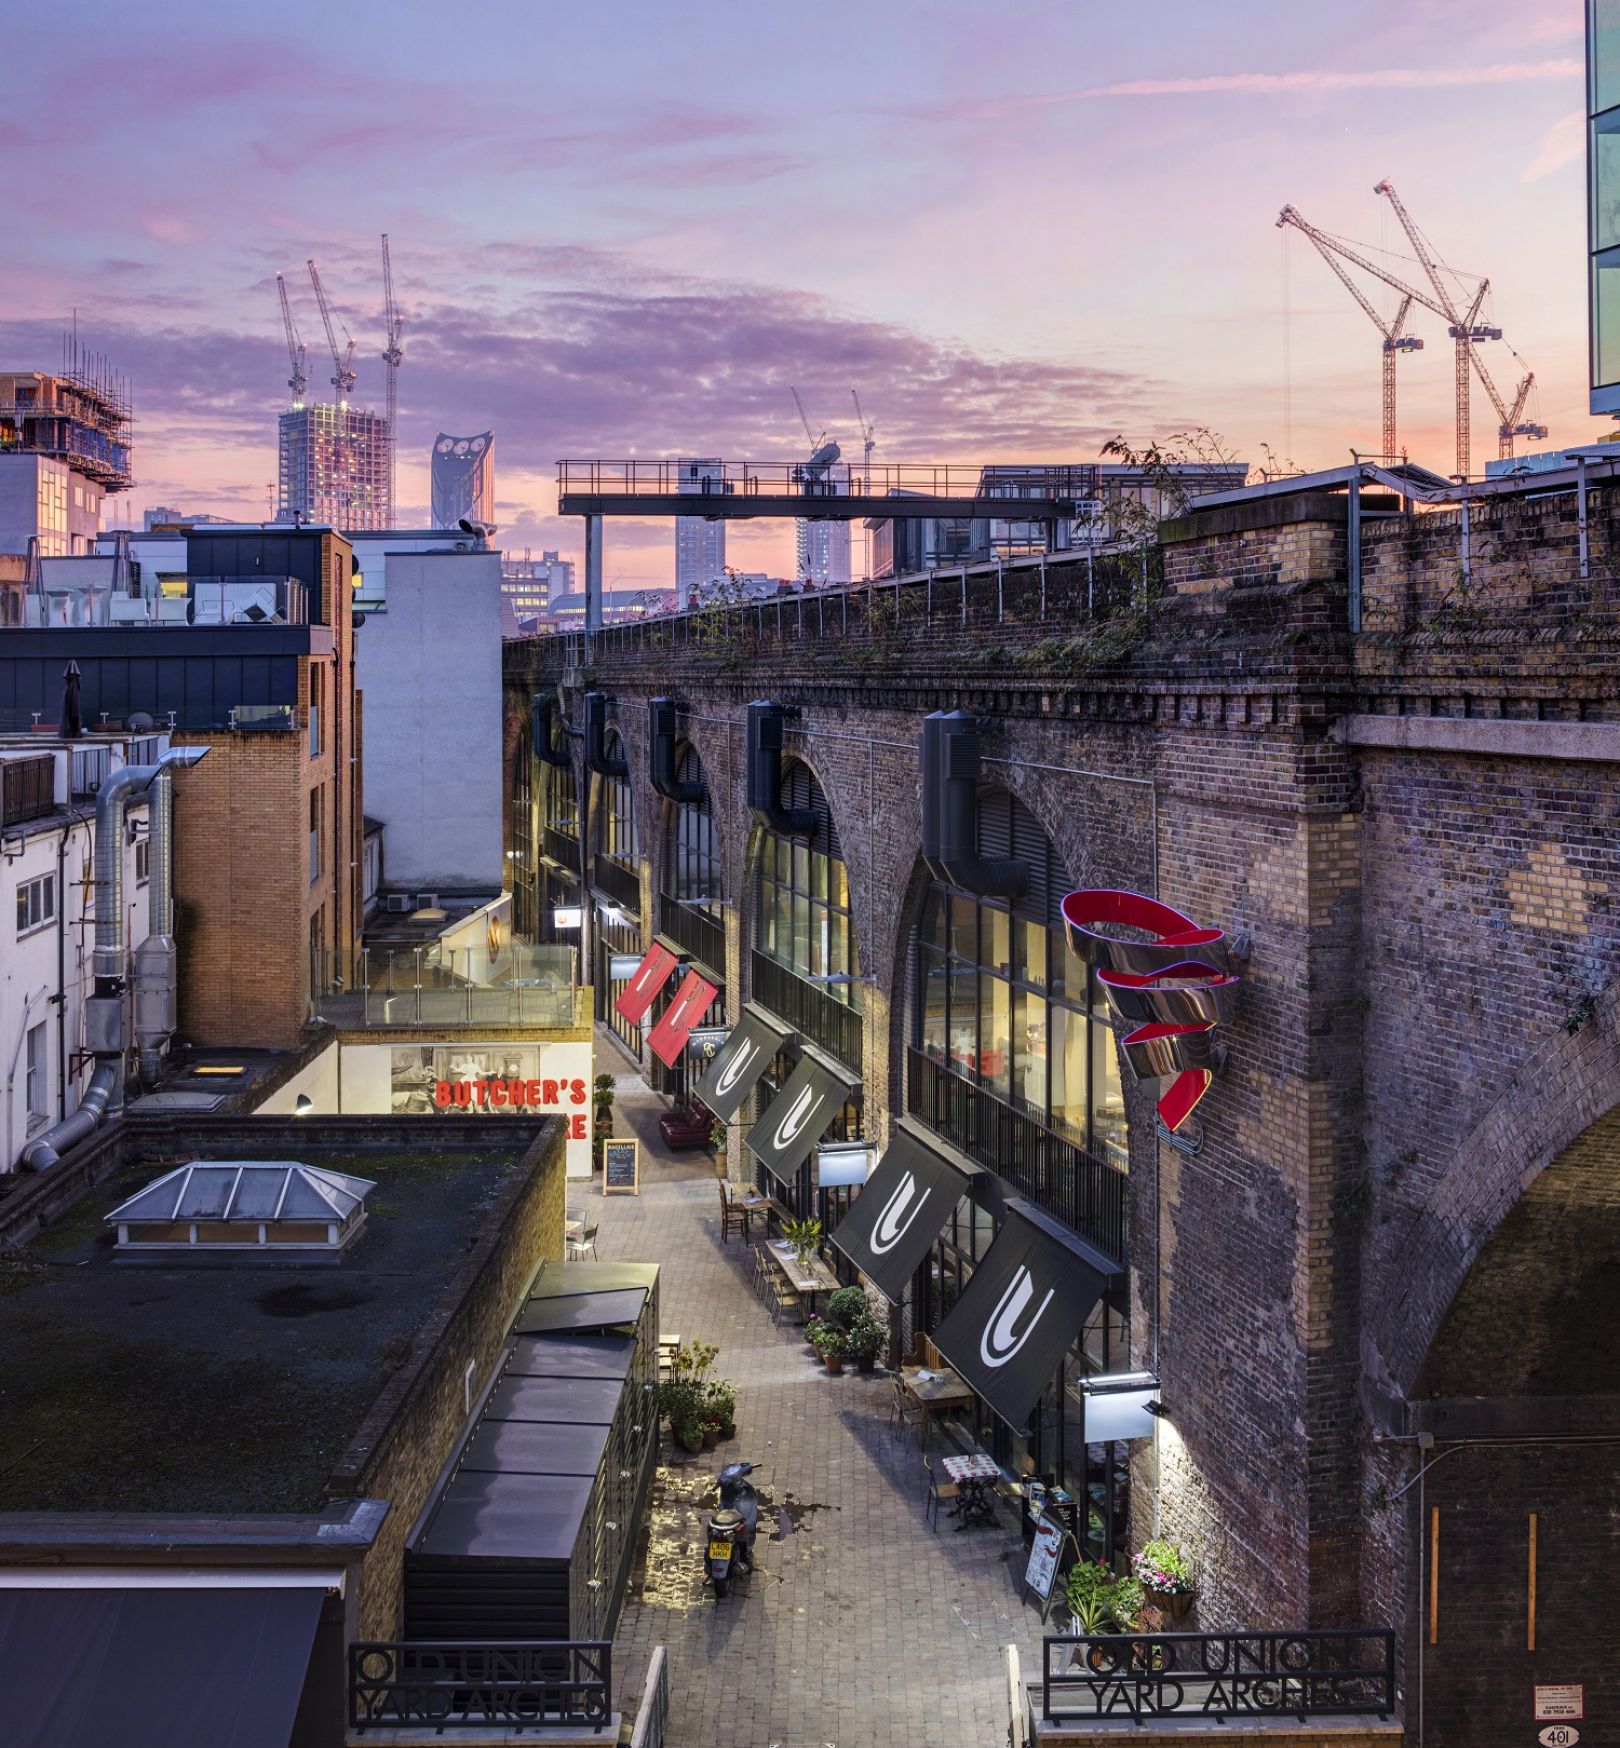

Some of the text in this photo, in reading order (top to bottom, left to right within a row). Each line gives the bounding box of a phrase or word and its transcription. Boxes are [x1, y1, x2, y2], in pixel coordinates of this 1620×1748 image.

[434, 1078, 587, 1107] BUTCHER'S
[460, 1648, 604, 1684] UNION
[1087, 1637, 1350, 1677] OLD UNION
[356, 1688, 605, 1720] YARD ARCHES
[1087, 1679, 1184, 1713] YARD
[1547, 1730, 1569, 1744] 401
